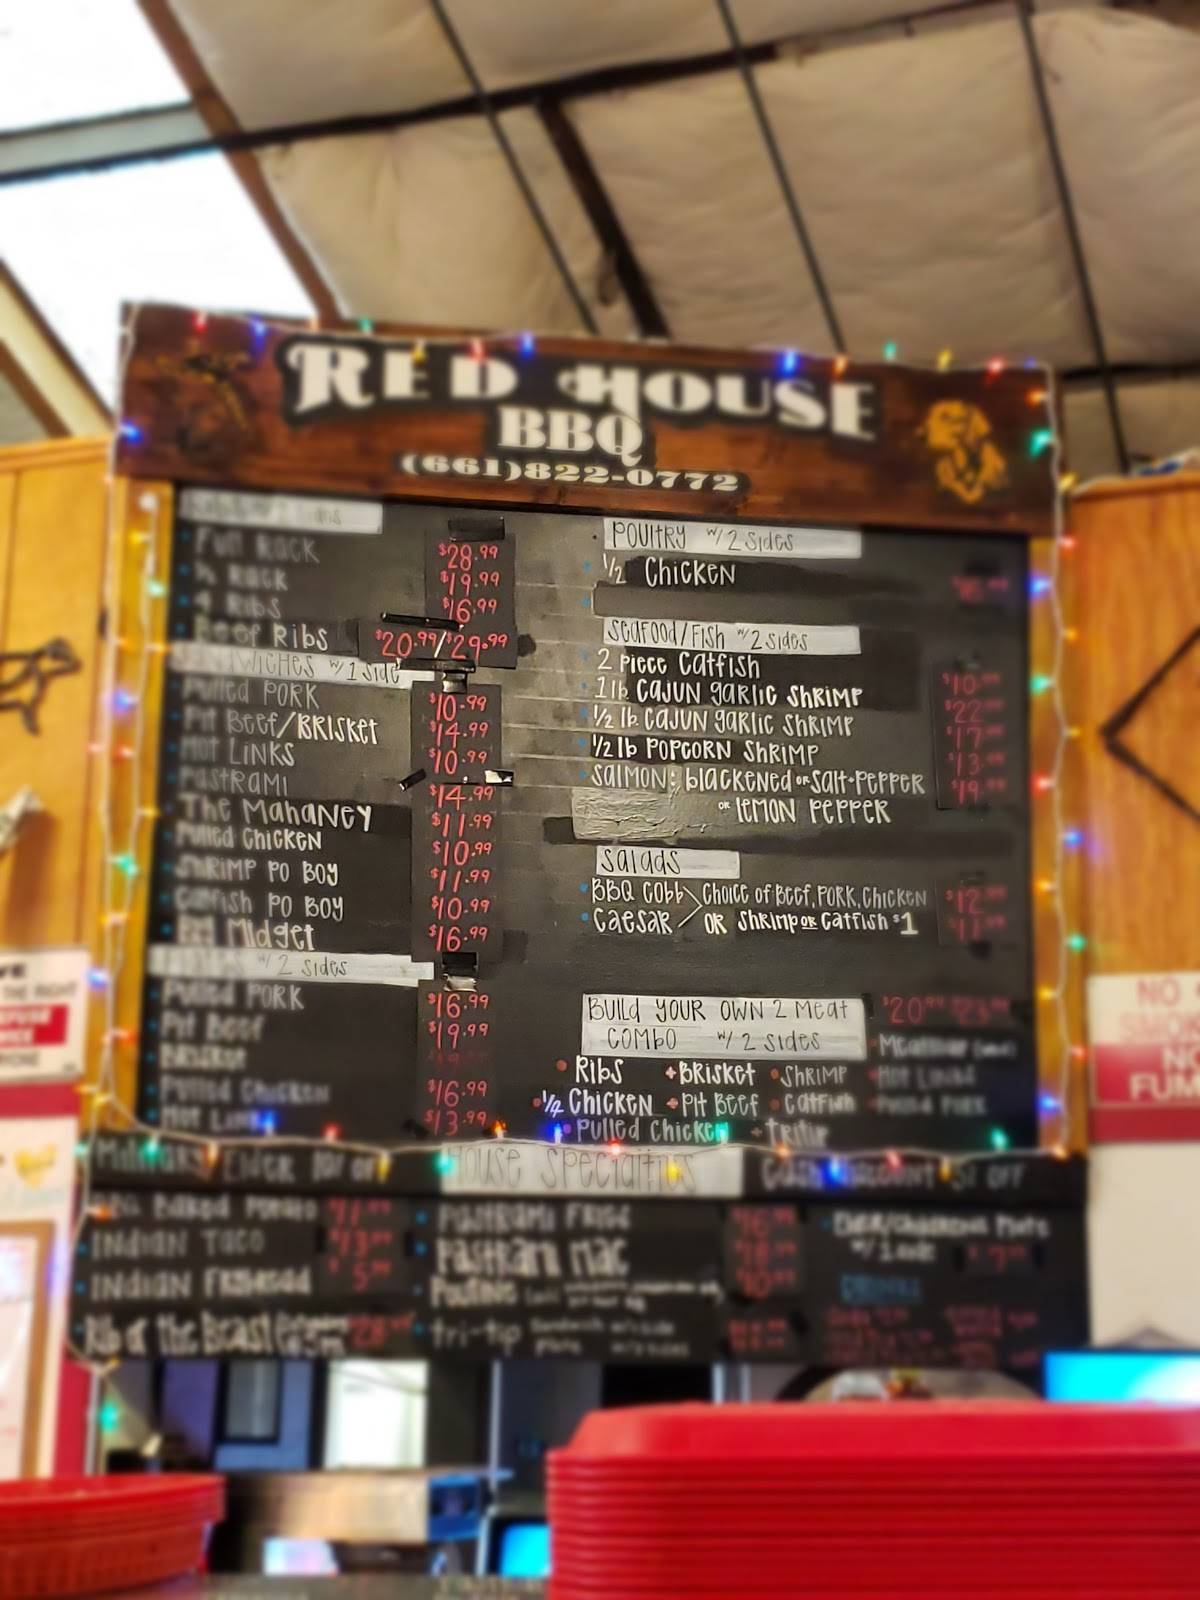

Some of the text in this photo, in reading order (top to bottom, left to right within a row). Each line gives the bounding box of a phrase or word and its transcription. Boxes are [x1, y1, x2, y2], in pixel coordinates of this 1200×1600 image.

[287, 344, 875, 440] RED HOUSE
[499, 407, 643, 466] BBQ
[401, 454, 739, 492] (661)822-0772
[728, 530, 742, 552] 2
[438, 544, 498, 571] $28.99
[440, 572, 499, 596] $19.99
[443, 598, 497, 624] $16.99
[274, 624, 329, 651] Ribs
[751, 630, 763, 649] 2
[598, 648, 612, 671] 2
[263, 683, 321, 710] PORK
[429, 693, 487, 720] $10.99
[430, 721, 489, 748] $14.99
[428, 749, 488, 774] $10.99
[646, 738, 731, 761] POPCORN
[429, 784, 494, 810] $14.99
[431, 812, 492, 838] $11.99
[432, 841, 492, 866] $10.99
[269, 861, 289, 883] PO
[430, 868, 490, 892] $11.99
[269, 893, 292, 916] PO
[592, 878, 634, 902] BBQ
[756, 884, 772, 905] of
[431, 896, 490, 920] $10.99
[705, 914, 728, 934] OR
[428, 924, 488, 952] $16.99
[278, 954, 294, 975] 2
[428, 992, 489, 1018] $16.99
[655, 998, 707, 1023] YOUR
[720, 999, 764, 1021] OWN
[772, 999, 787, 1019] 2
[428, 1022, 489, 1049] $19.99
[743, 1032, 755, 1052] 2
[575, 1058, 624, 1084] Ribs
[428, 1080, 488, 1108] $16.99
[714, 1092, 759, 1116] Beef
